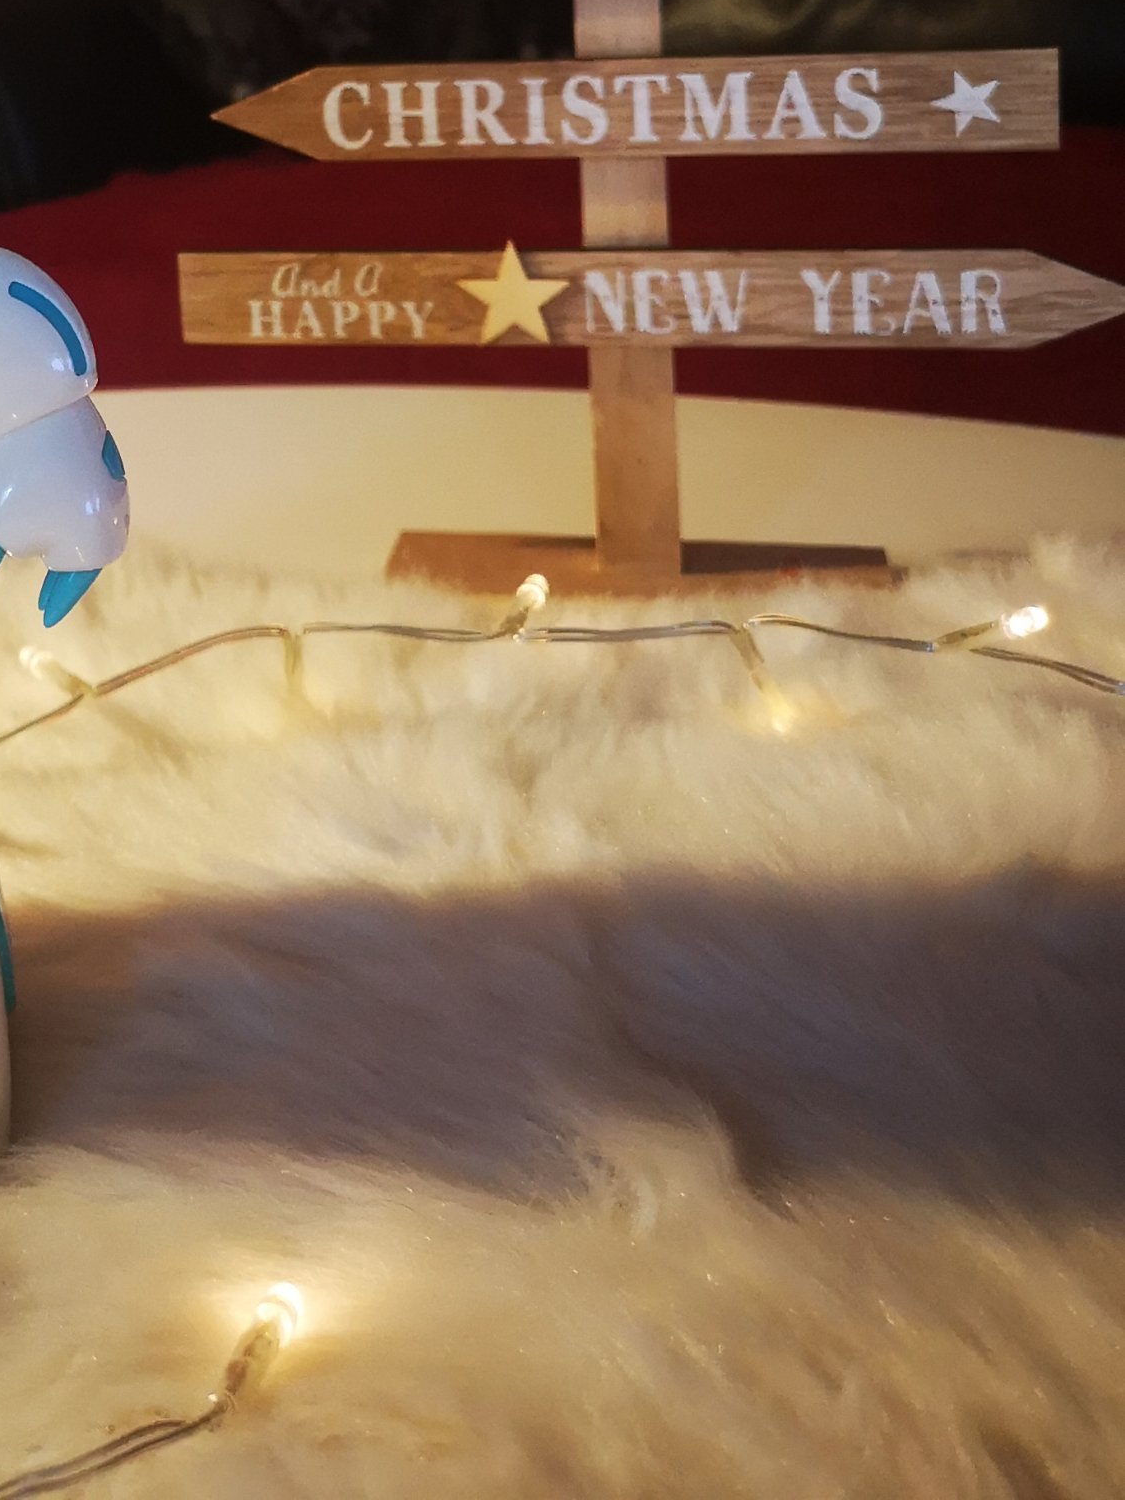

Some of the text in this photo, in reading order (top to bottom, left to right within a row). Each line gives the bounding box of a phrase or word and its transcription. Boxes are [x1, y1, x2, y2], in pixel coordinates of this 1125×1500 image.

[322, 66, 885, 151] CHRISTMAS
[271, 262, 342, 299] And
[582, 267, 1008, 338] NEW YEAR
[248, 299, 435, 340] HAPPY
